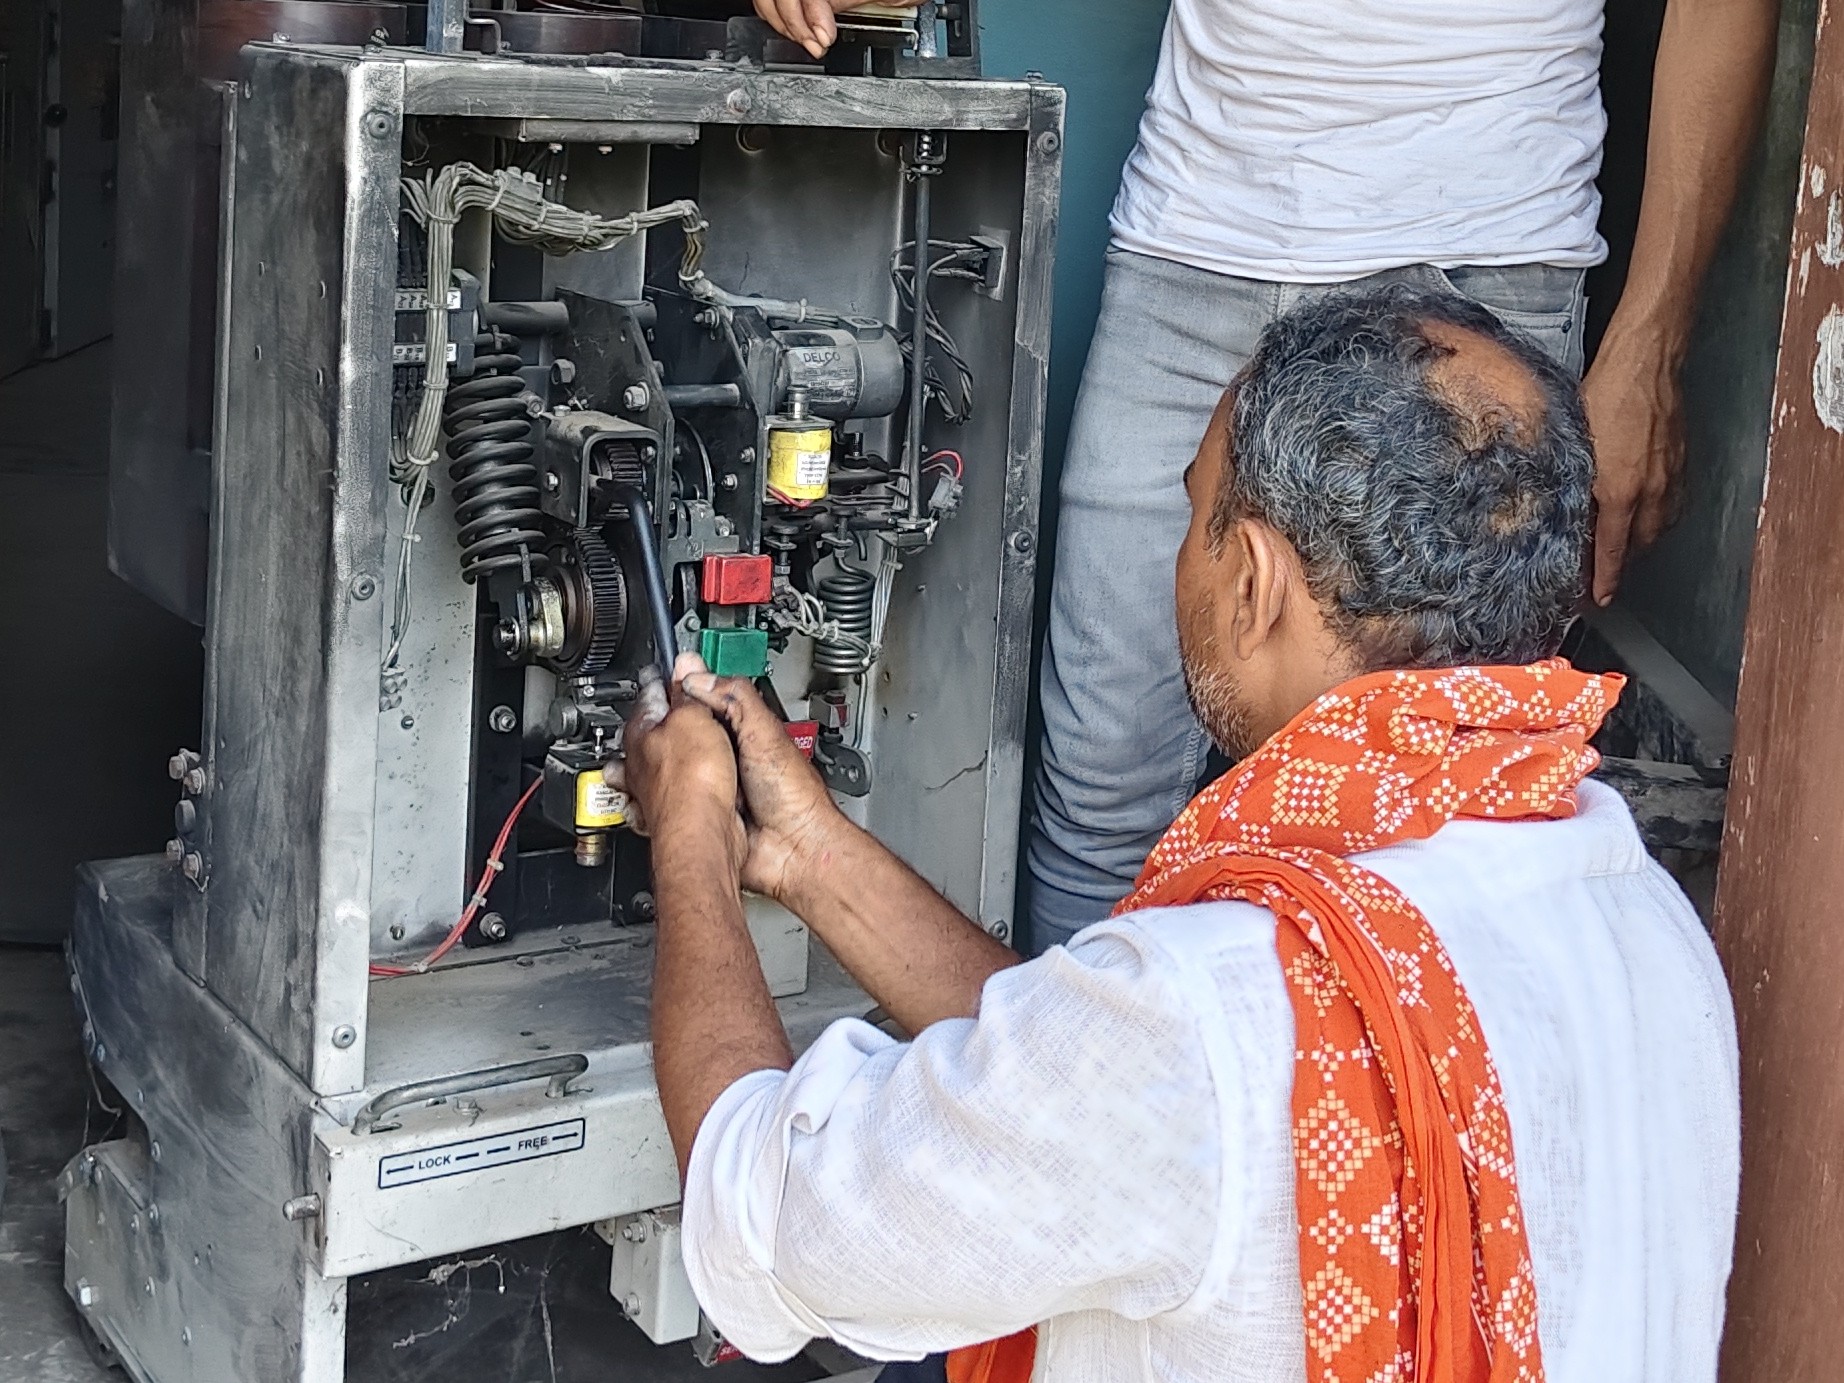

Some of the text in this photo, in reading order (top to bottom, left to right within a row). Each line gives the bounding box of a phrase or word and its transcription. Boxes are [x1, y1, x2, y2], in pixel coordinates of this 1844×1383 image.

[803, 351, 840, 363] DELCO
[418, 1135, 548, 1170] LOCK FREE
